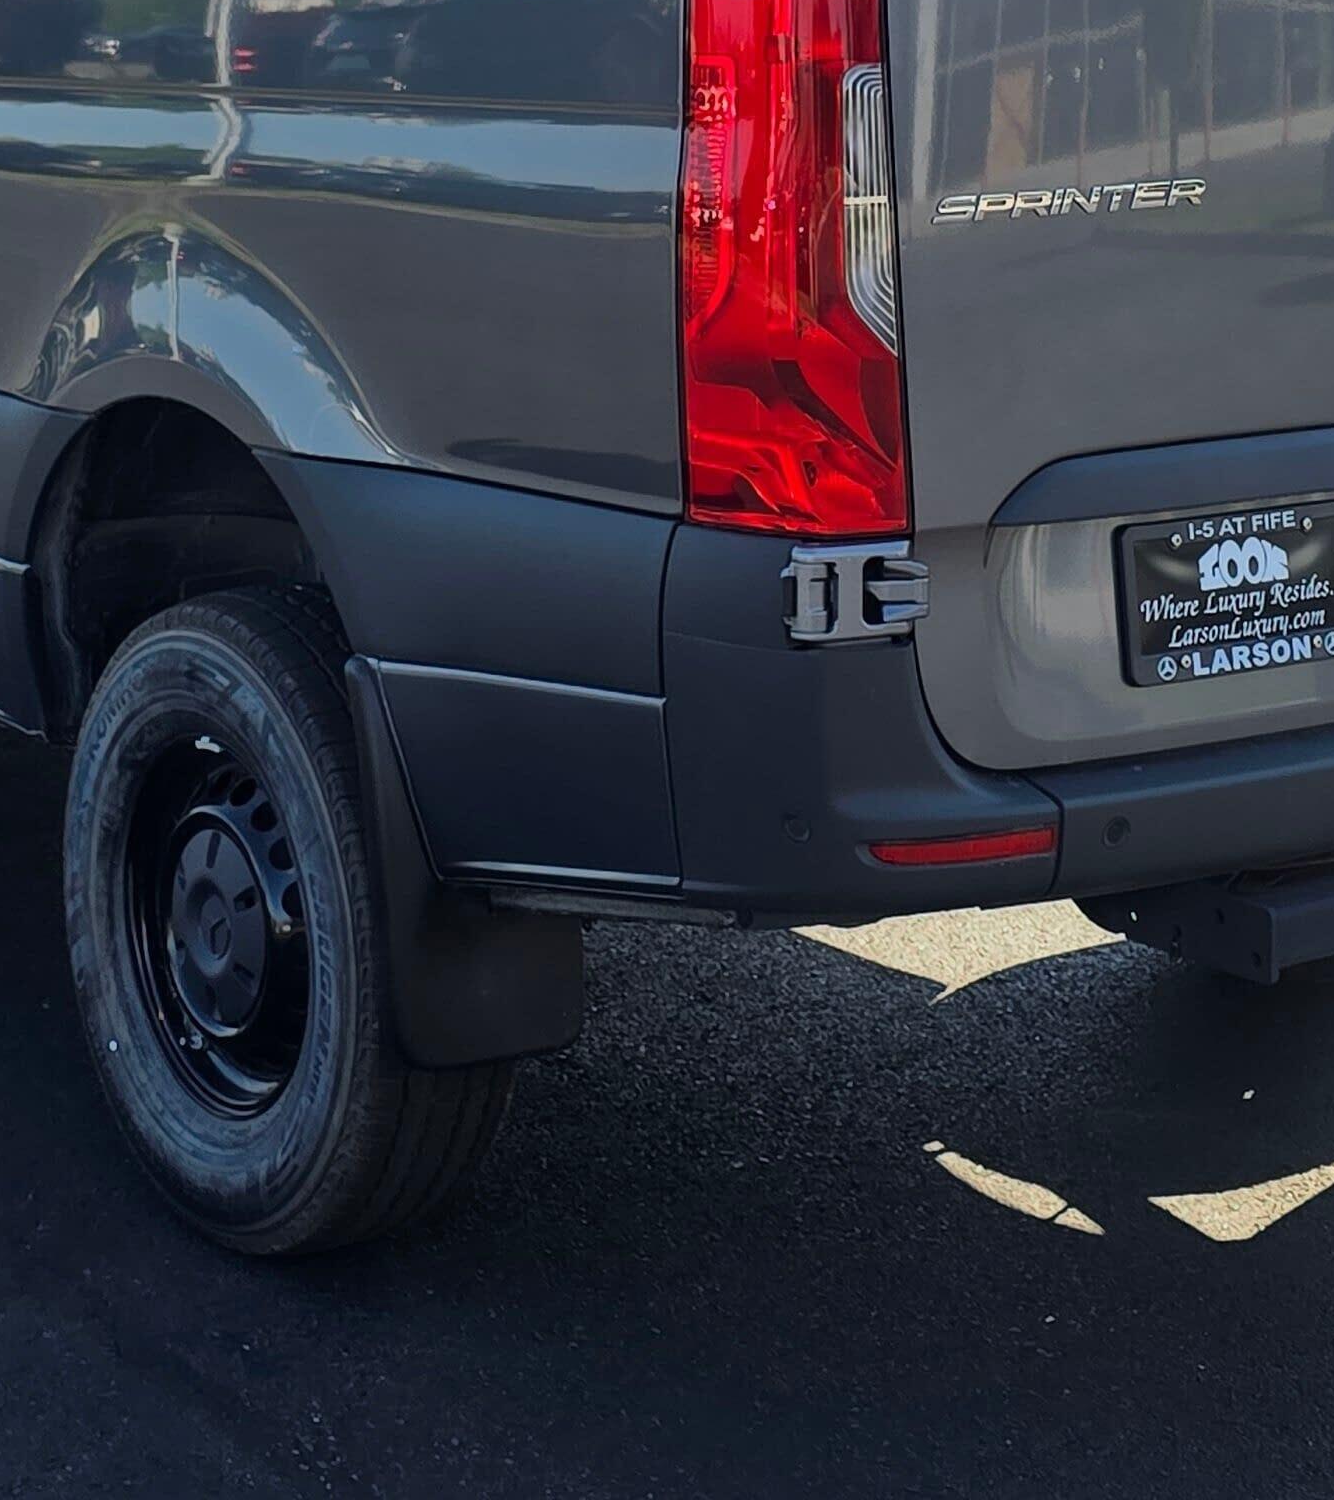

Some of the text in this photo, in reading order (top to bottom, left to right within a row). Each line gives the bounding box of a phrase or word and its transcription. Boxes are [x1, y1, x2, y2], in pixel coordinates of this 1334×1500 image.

[931, 177, 1206, 225] SPRINTER
[1187, 510, 1296, 540] I-5 AT FIFE
[1140, 594, 1200, 624] Where
[1203, 588, 1266, 617] Luxury
[1168, 608, 1326, 649] LarsonLuxury.com
[1191, 634, 1313, 677] LARSON
